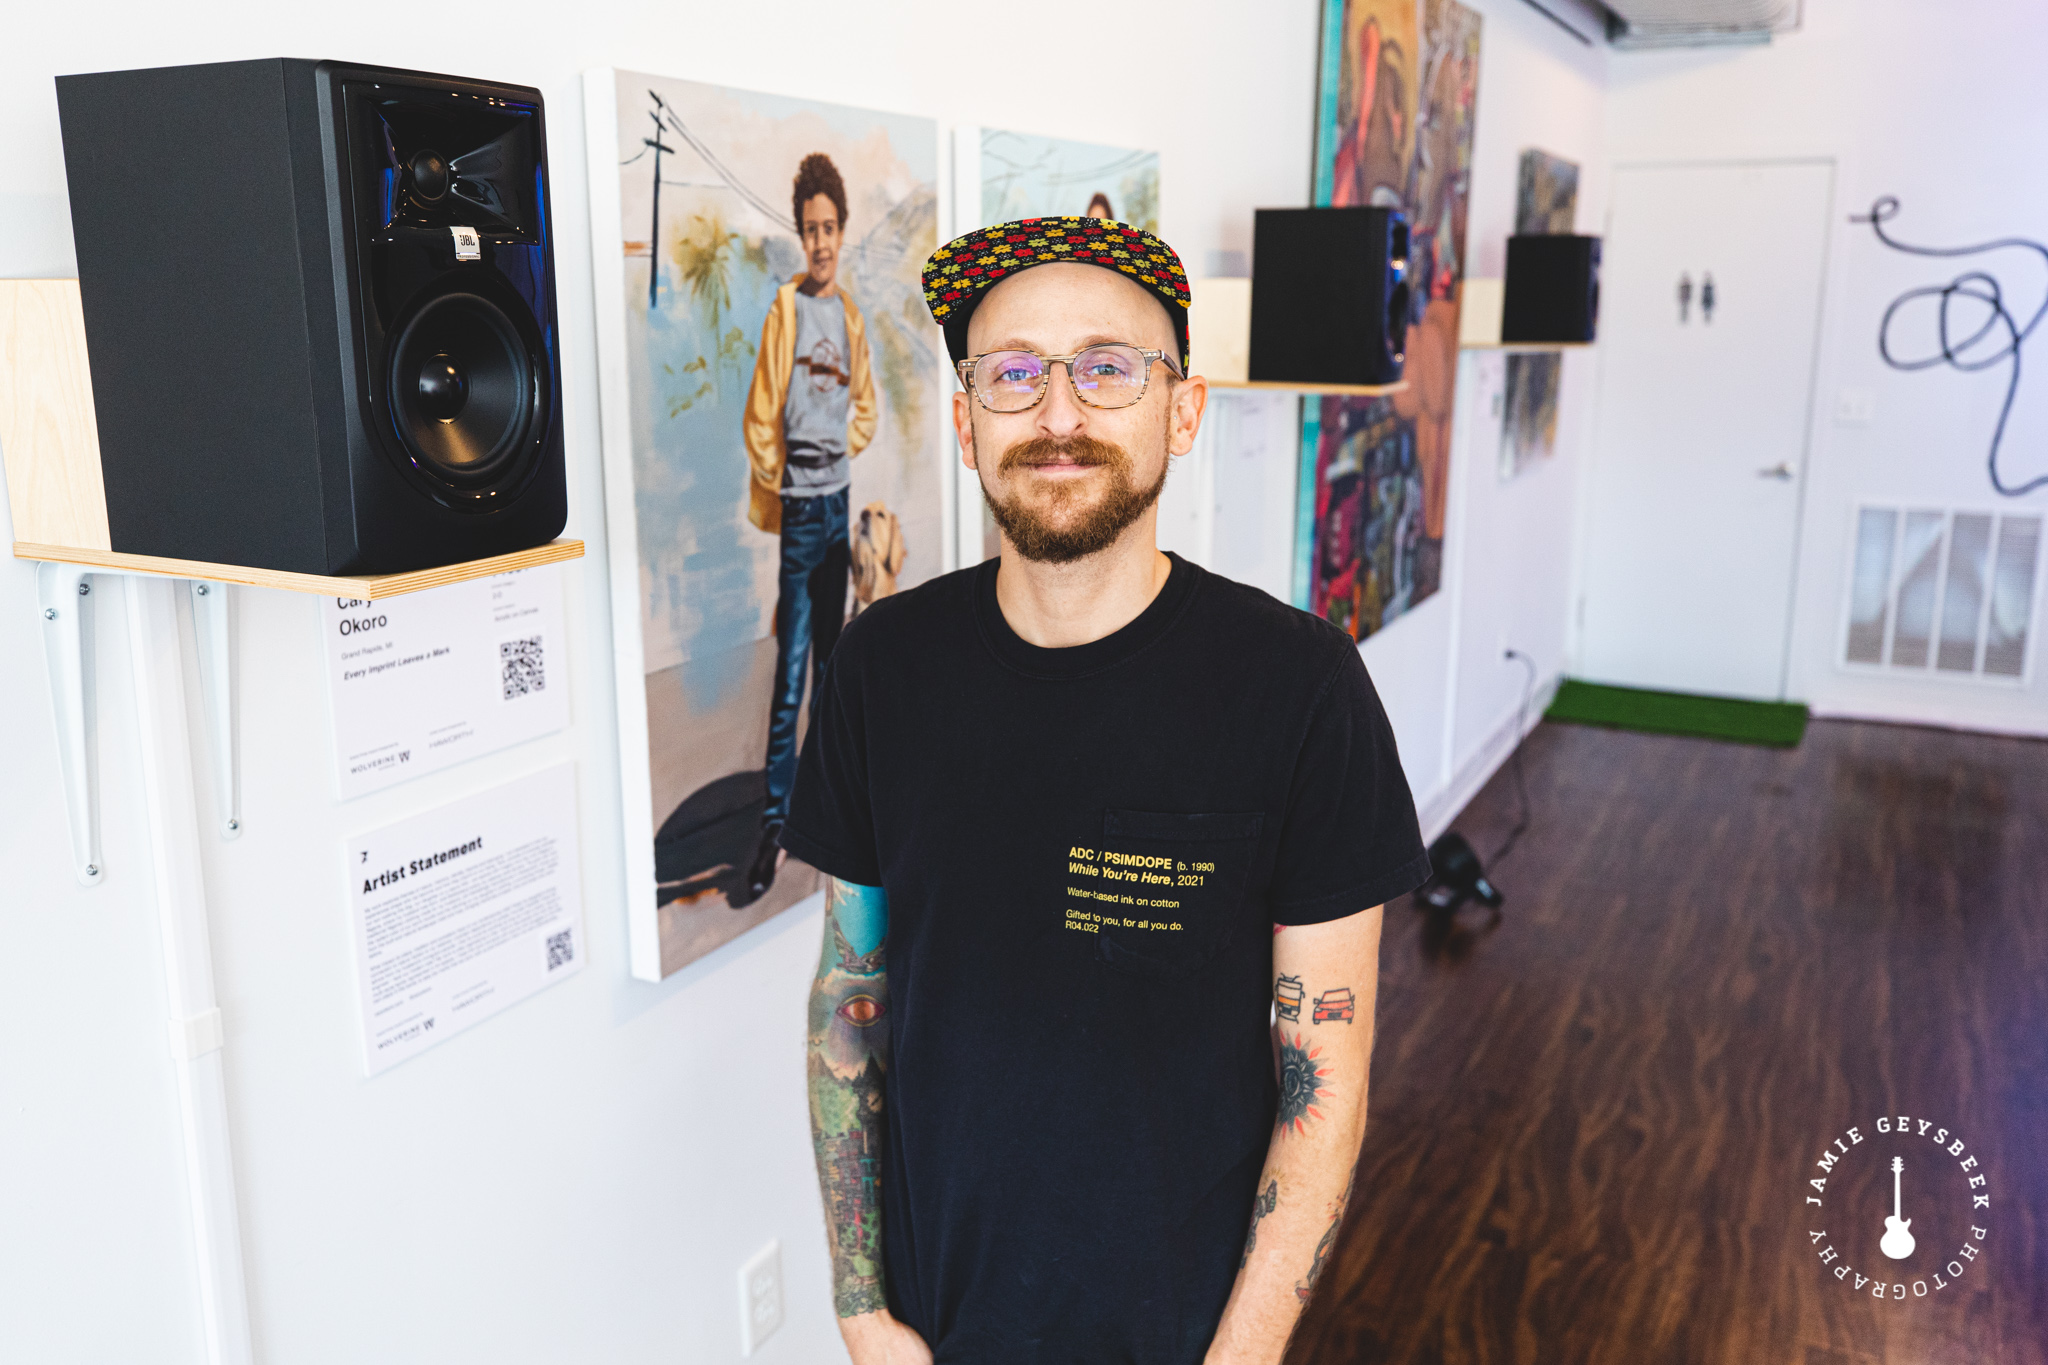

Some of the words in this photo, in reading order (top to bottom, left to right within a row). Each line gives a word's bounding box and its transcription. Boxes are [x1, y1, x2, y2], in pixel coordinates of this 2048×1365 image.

[459, 235, 475, 246] JBL
[339, 615, 387, 636] Okoro
[341, 649, 361, 660] Grand
[344, 669, 367, 680] Every
[369, 660, 397, 674] Imprint
[398, 655, 424, 667] Leaves
[433, 647, 450, 658] Mark
[350, 754, 395, 774] WOLVERINE
[363, 866, 406, 894] Artist
[410, 836, 483, 875] Statement
[1069, 846, 1094, 860] ADC
[1104, 852, 1172, 869] PSIMDOPE
[1177, 861, 1188, 872] (b.
[1192, 862, 1215, 873] 1990)
[1069, 862, 1099, 877] While
[1102, 867, 1138, 882] You're
[1141, 872, 1175, 887] Here,
[1177, 875, 1204, 886] 2021
[1067, 887, 1118, 903] Water-based
[1120, 895, 1134, 905] ink
[1136, 898, 1148, 906] on
[1150, 899, 1180, 908] cotton
[1065, 920, 1099, 934] R04.022
[1066, 909, 1091, 921] Gifted
[1093, 913, 1101, 922] to
[1102, 917, 1121, 927] you,
[1123, 918, 1136, 927] for
[1138, 920, 1148, 929] all
[1150, 922, 1167, 931] you
[1170, 922, 1184, 931] do.
